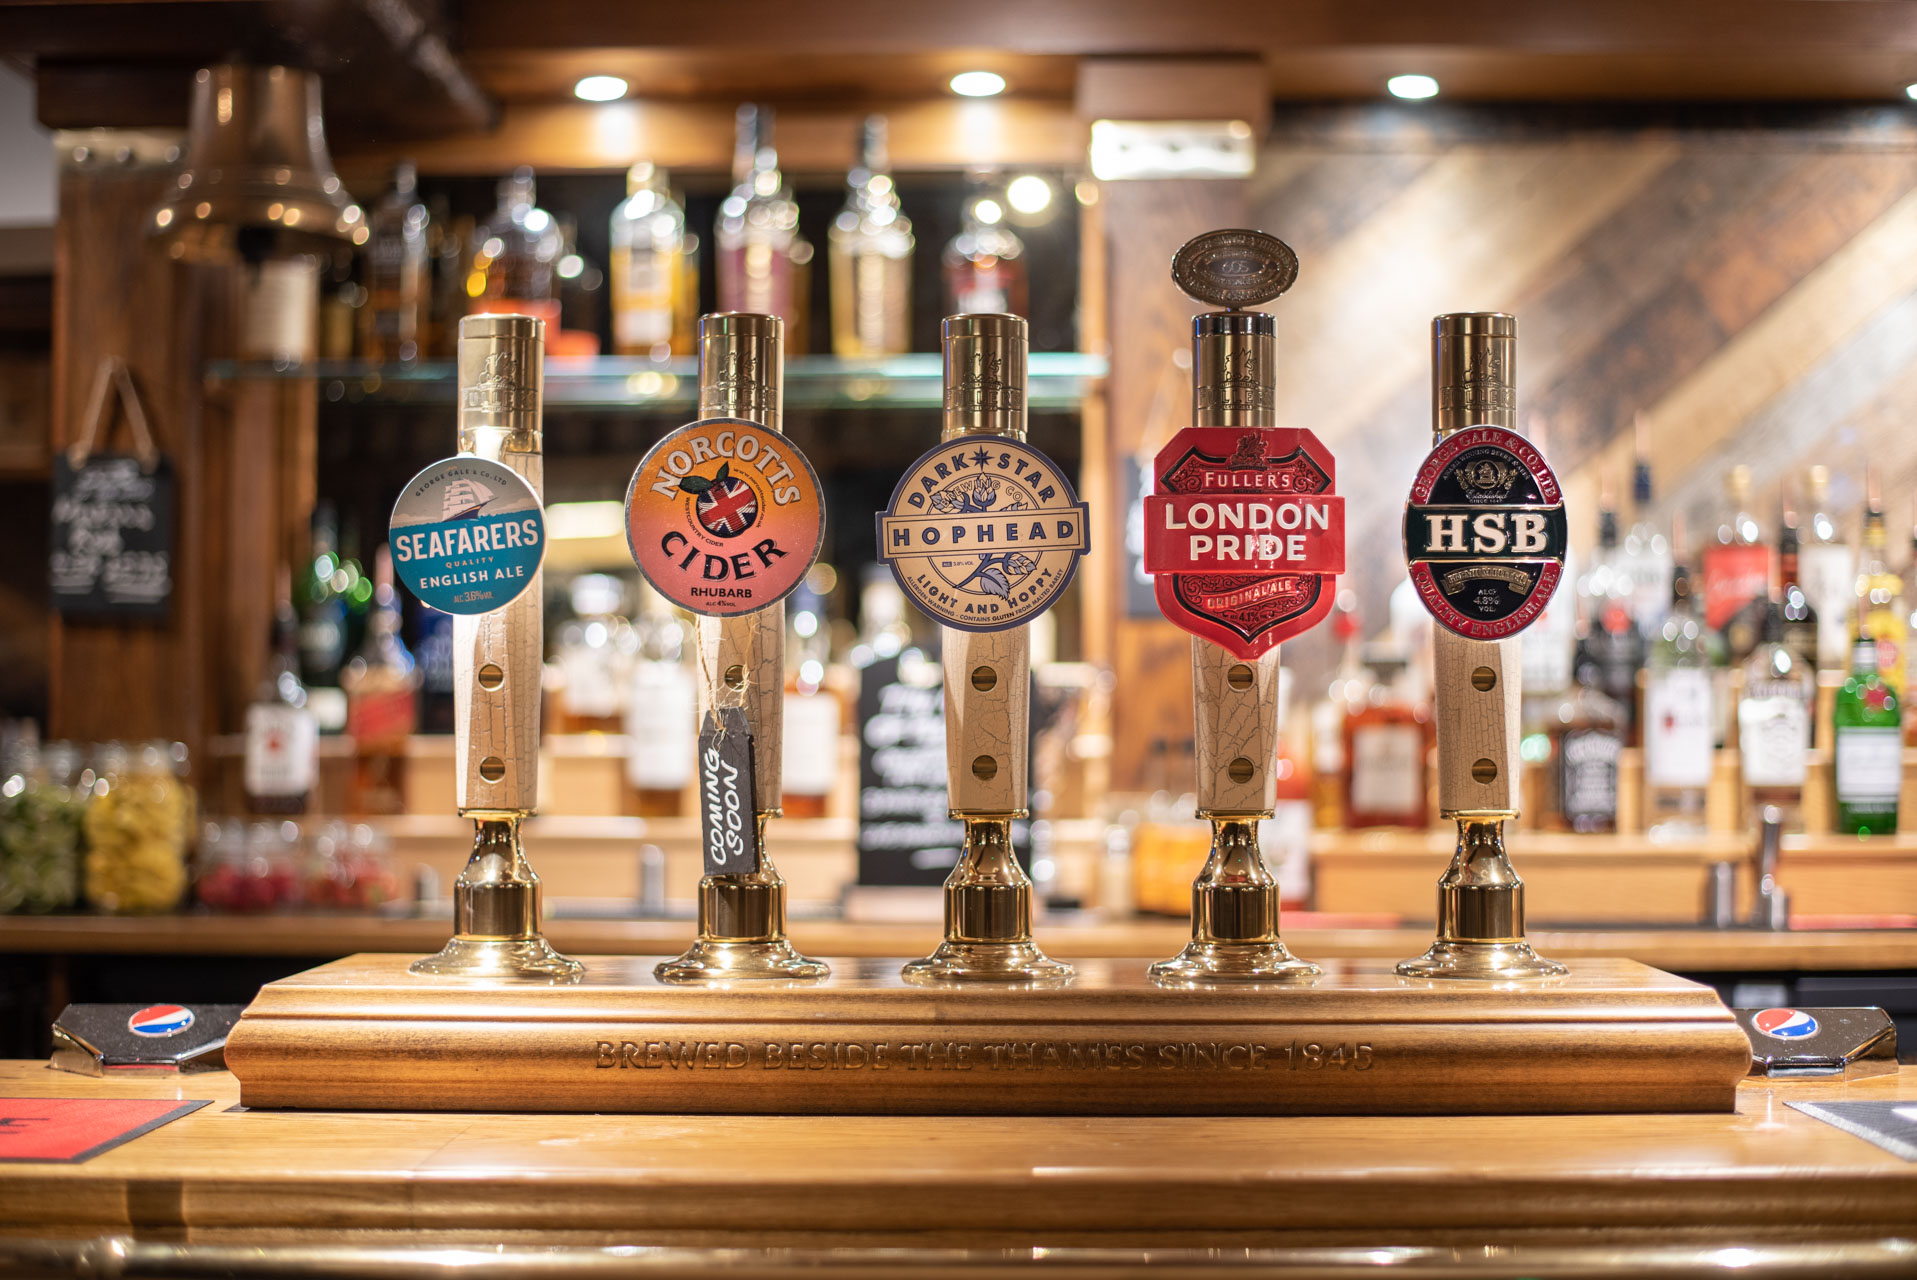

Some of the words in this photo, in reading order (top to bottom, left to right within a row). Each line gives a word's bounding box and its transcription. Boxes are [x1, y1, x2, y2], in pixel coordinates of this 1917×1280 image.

[651, 431, 801, 507] NORCOTTS
[1415, 443, 1459, 498] GEORGE
[1459, 430, 1502, 447] GALE
[415, 473, 445, 497] GEORGE
[447, 468, 469, 478] GALE
[493, 475, 507, 486] LTD
[908, 452, 971, 509] DARK
[997, 453, 1055, 504] STAR
[940, 479, 1001, 508] BREWING
[1005, 485, 1023, 501] CO
[1165, 503, 1329, 530] LONDON
[396, 519, 539, 562] SEAFARERS
[705, 538, 724, 547] CIDER
[893, 520, 1074, 547] HOPHEAD
[1190, 534, 1307, 561] PRIDE
[1426, 513, 1548, 553] HSB
[445, 556, 494, 569] QUALITY
[661, 531, 789, 582] CIDER
[420, 570, 488, 589] ENGLISH
[495, 565, 525, 580] ALE
[691, 587, 752, 599] RHUBARB
[917, 573, 958, 608] LIGHT
[965, 603, 999, 614] AND
[1007, 568, 1052, 609] HOPPY
[907, 576, 929, 601] ALLERGEN
[927, 598, 955, 617] WARNING
[960, 614, 991, 622] CONTAINS
[992, 612, 1014, 622] GLUTEN
[1015, 605, 1032, 614] FROM
[1031, 588, 1051, 606] MALTED
[1049, 568, 1064, 588] BARLEY
[1207, 585, 1267, 609] ORIGINAL
[1269, 580, 1292, 594] ALE
[1416, 571, 1468, 631] QUALITY
[1471, 602, 1540, 636] ENGLISH
[1473, 596, 1499, 605] 4.8%
[704, 747, 727, 865] COMING
[720, 759, 744, 856] SOON
[596, 1040, 750, 1070] BREWED
[763, 1041, 891, 1071] BESIDE
[900, 1041, 973, 1071] THE
[983, 1041, 1146, 1071] THAMES
[1157, 1041, 1269, 1071] SINCE
[1284, 1040, 1374, 1072] 1845
